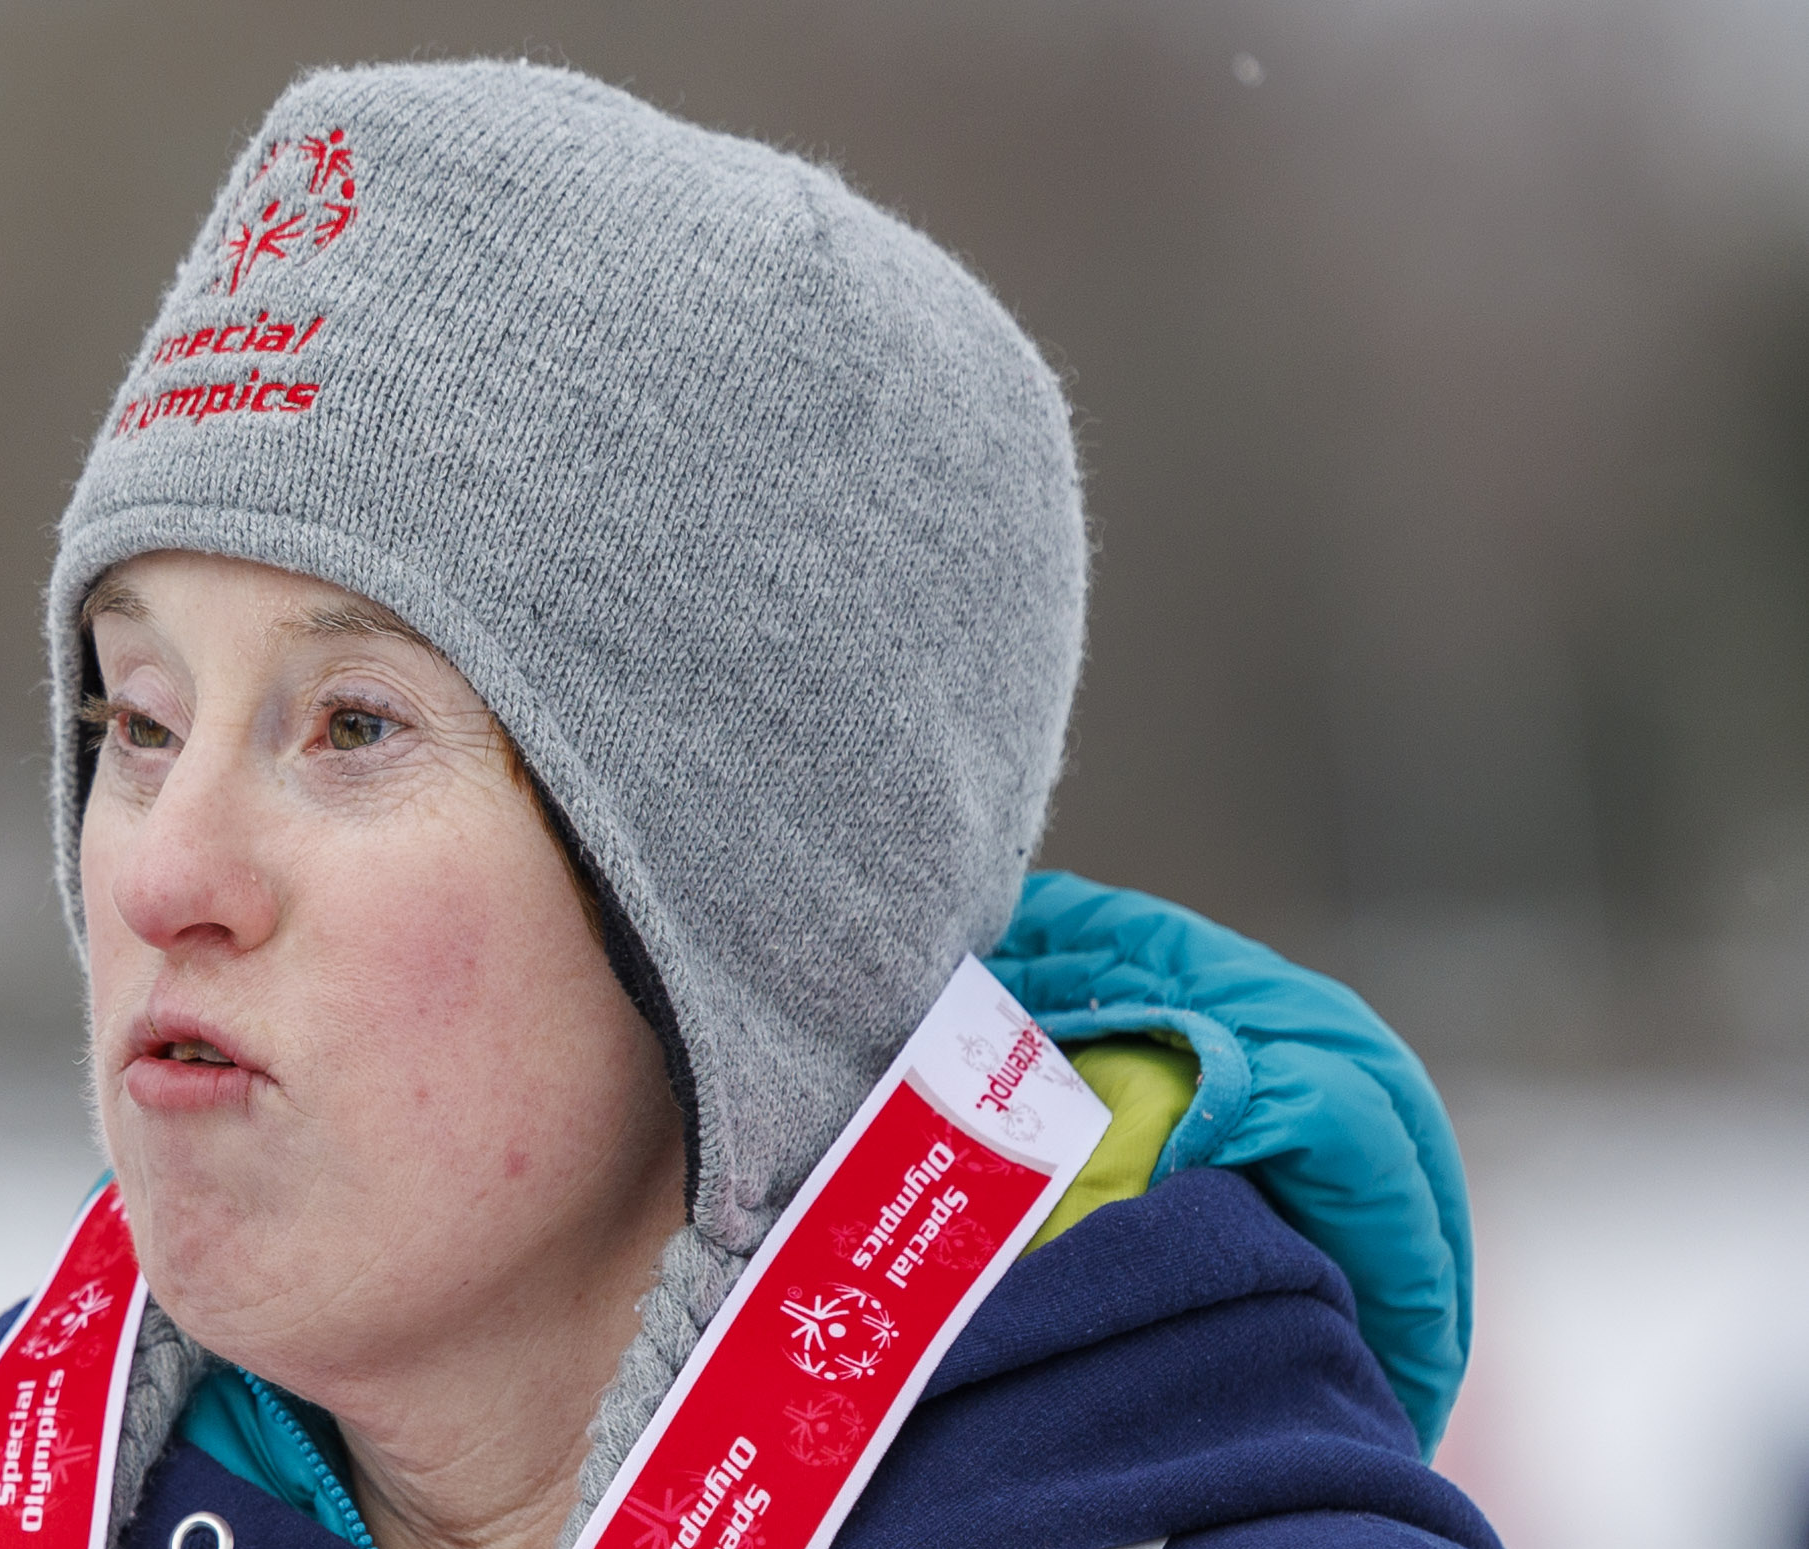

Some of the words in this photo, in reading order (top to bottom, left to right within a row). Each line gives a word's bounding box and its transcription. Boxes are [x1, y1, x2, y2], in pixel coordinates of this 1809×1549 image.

[152, 311, 327, 365] pecial
[115, 368, 321, 438] lympics
[975, 1029, 1043, 1113] attempt.
[851, 1141, 957, 1271] Olympics
[885, 1185, 969, 1289] Special
[20, 1368, 65, 1533] Olympics
